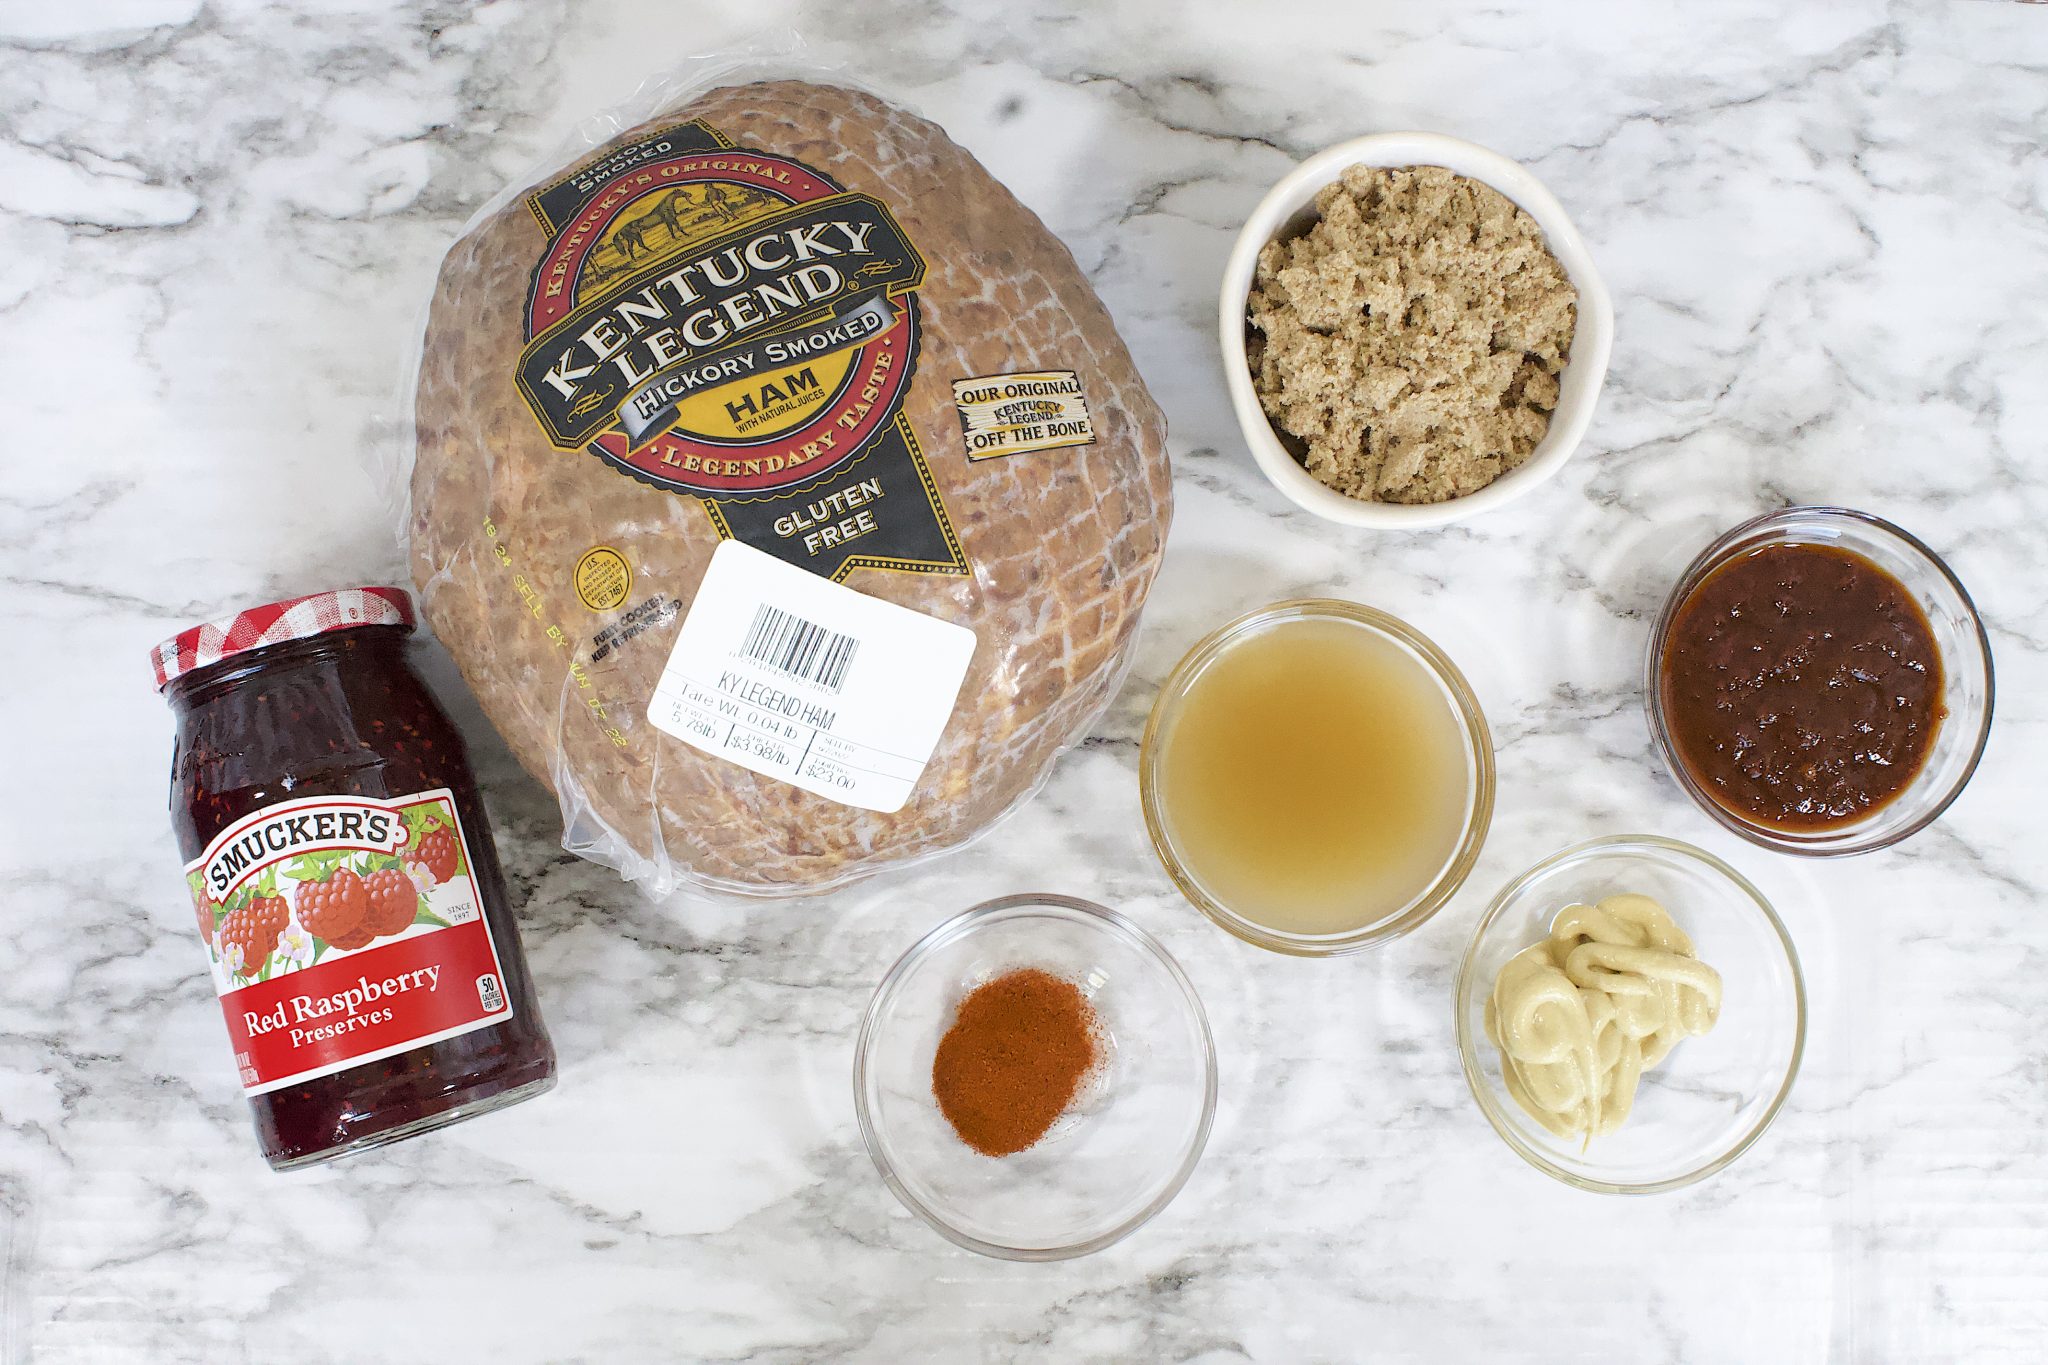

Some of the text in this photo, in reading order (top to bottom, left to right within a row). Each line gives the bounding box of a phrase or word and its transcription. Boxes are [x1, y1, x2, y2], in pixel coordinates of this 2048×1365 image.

[570, 136, 664, 186] HICKOR
[578, 142, 672, 193] SMOKED
[545, 160, 792, 299] KENTUCKY'S ORIGINAL
[541, 220, 877, 404] KENTUCKY
[610, 263, 843, 391] LEGEND
[632, 311, 881, 417] HICKORY SMOKED
[660, 350, 894, 477] LEGENDARY TASTE
[723, 366, 821, 424] HAM
[736, 388, 826, 434] WITH NATURAL JUICES
[962, 381, 1077, 403] OUR ORIGINAL
[993, 400, 1060, 421] KENTUCKY
[973, 421, 1088, 448] OFF THE BONE
[1008, 412, 1054, 425] LEGEND
[773, 476, 884, 538] GLUTEN
[802, 510, 879, 557] FREE
[585, 557, 600, 570] U.S.
[513, 575, 543, 620] SELL
[682, 682, 714, 706] Tare
[748, 712, 780, 733] 0.04
[718, 670, 742, 694] KY
[740, 679, 801, 717] LEGEND
[800, 702, 836, 730] HAM
[806, 764, 856, 790] $23.00
[210, 809, 390, 893] SMUCKER'S
[447, 902, 471, 914] SINCE
[454, 911, 470, 921] 1897
[243, 964, 442, 1038] Red Raspberry
[482, 977, 494, 992] 50
[289, 1007, 393, 1049] Preserves
